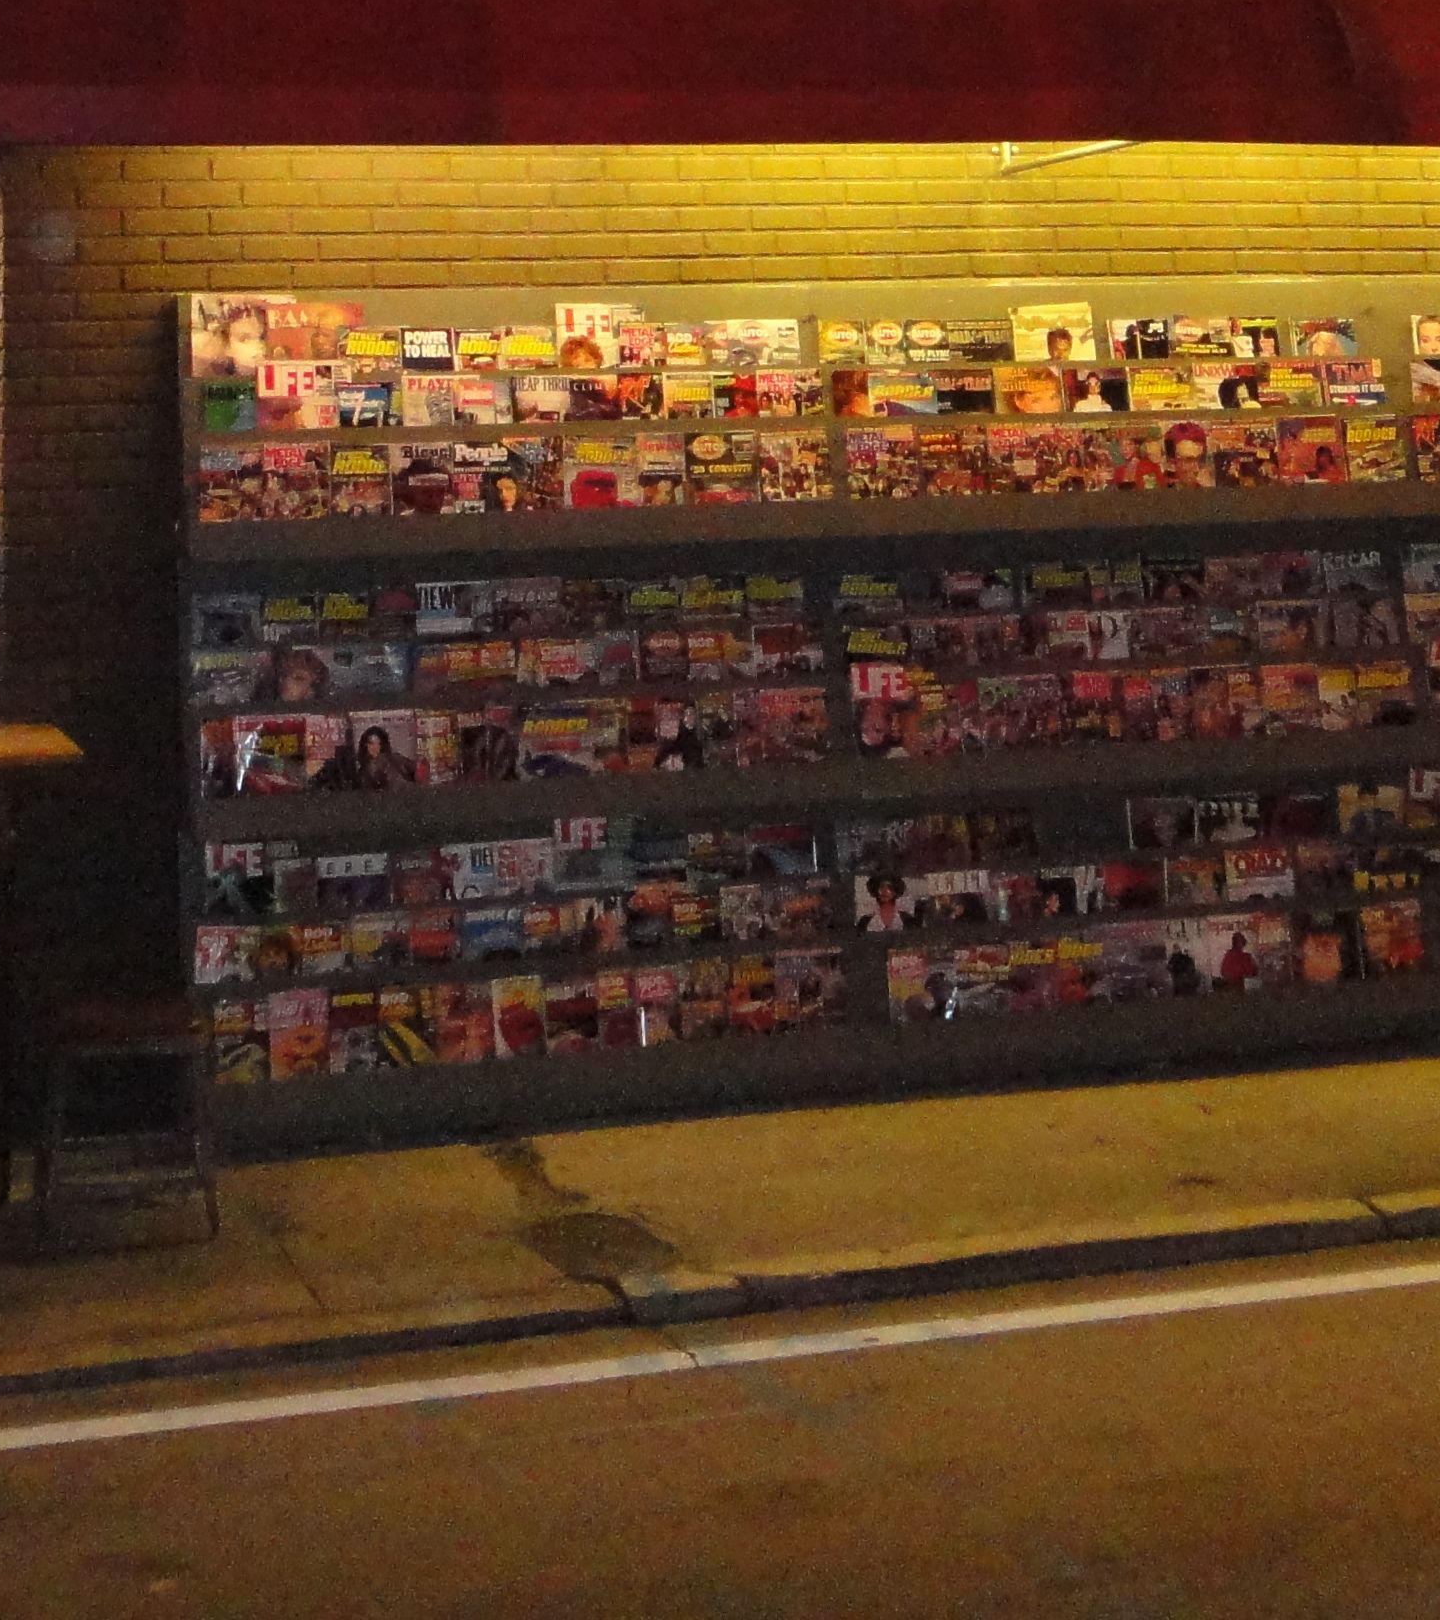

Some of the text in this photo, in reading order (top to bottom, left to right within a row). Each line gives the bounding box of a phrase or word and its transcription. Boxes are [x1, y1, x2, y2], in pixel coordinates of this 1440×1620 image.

[404, 331, 448, 344] POWER
[404, 344, 451, 357] TO HEAL
[455, 443, 509, 462] People
